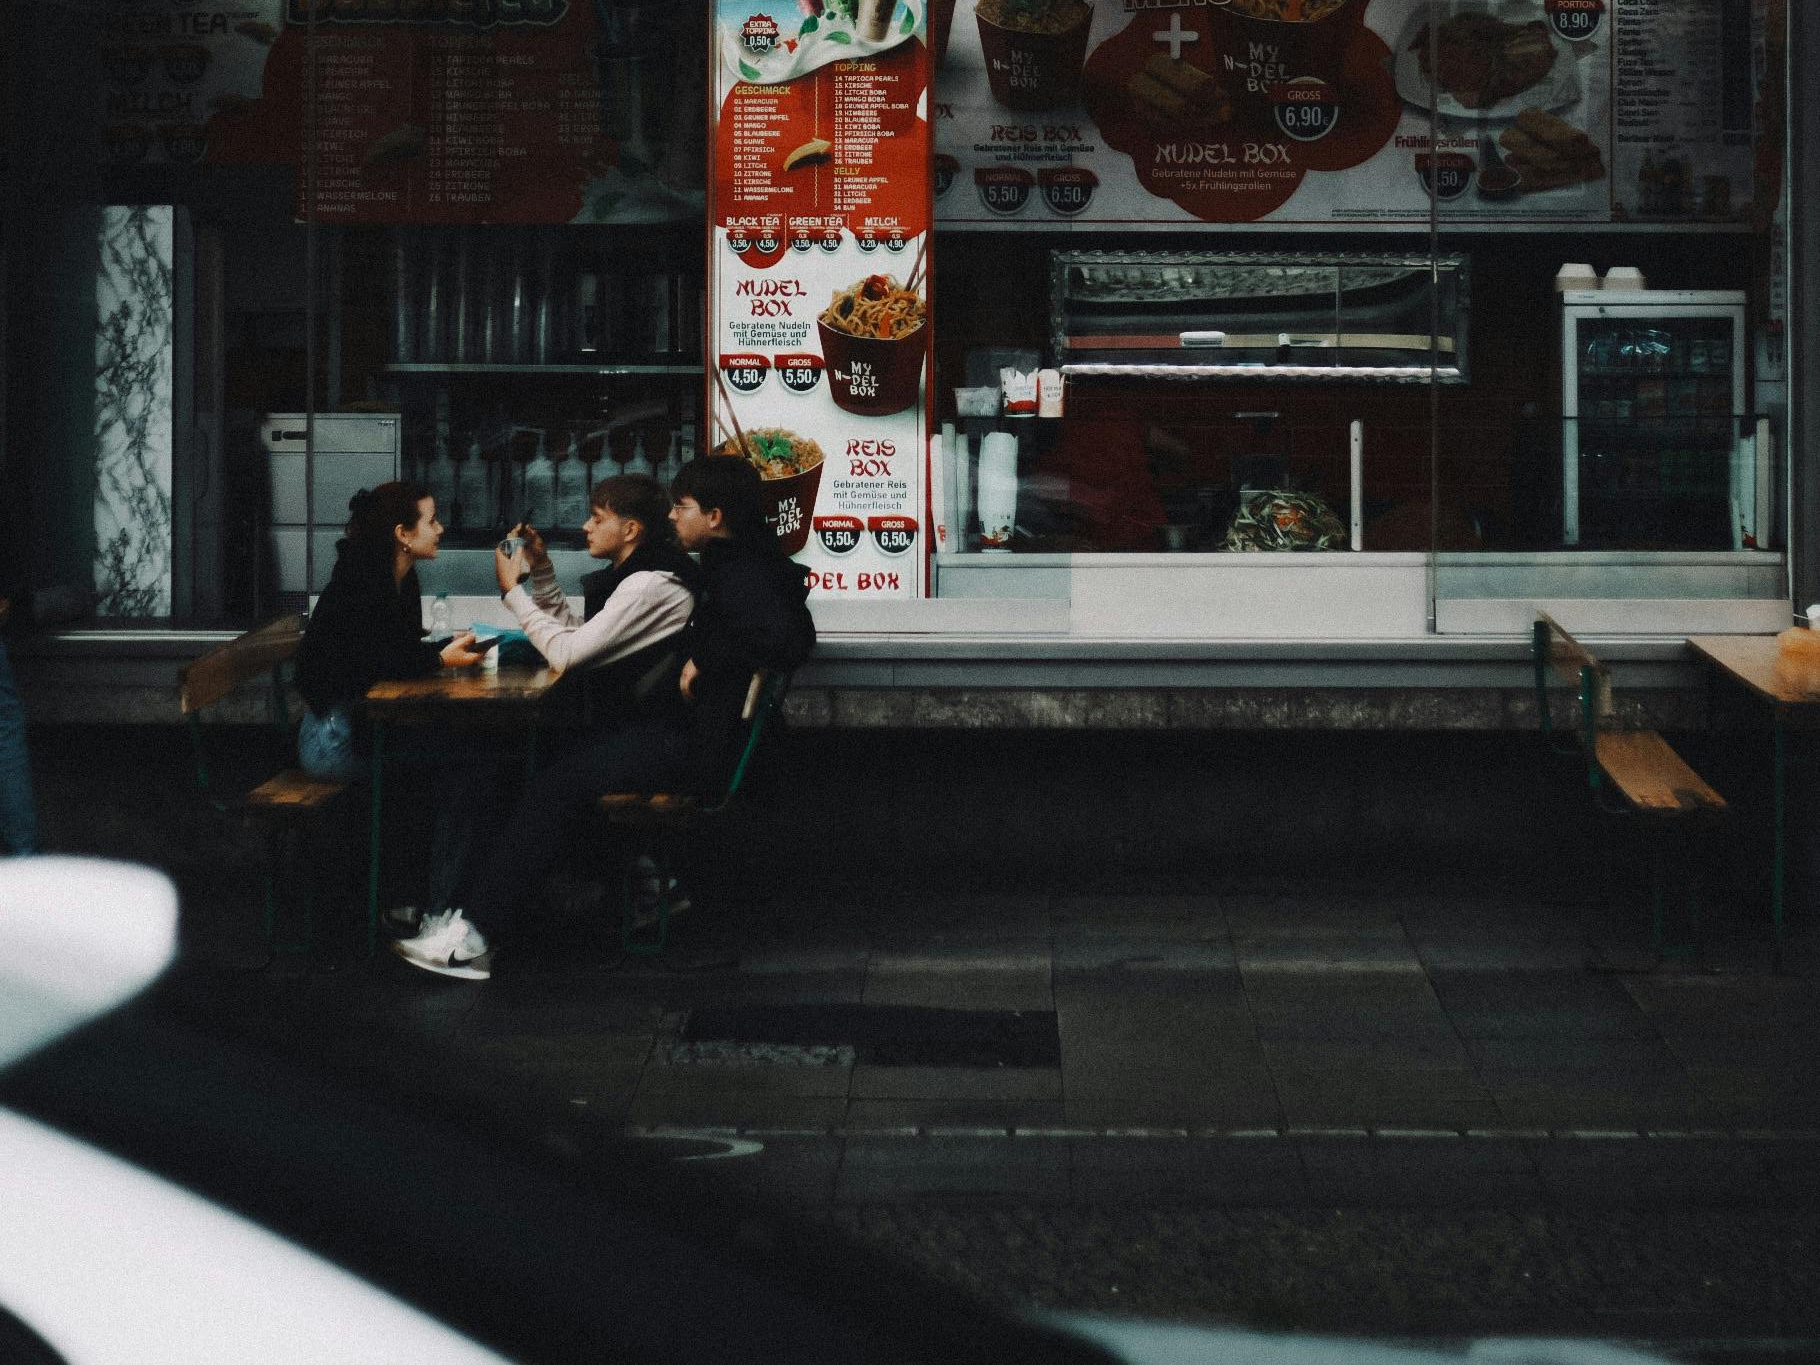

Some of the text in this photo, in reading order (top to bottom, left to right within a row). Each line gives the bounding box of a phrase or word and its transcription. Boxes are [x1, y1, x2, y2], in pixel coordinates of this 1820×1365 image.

[1558, 0, 1596, 8] PORTION
[749, 20, 772, 28] EXTRA
[745, 27, 777, 35] TOPPING
[1248, 41, 1278, 62] MY
[834, 63, 877, 72] TOPPING
[735, 86, 791, 95] GESCHMACK
[1287, 90, 1320, 100] GROSS
[990, 124, 1082, 142] REIS BOX
[1395, 136, 1479, 149] Frühlisrollen
[974, 144, 1020, 152] Gebratener
[1154, 143, 1292, 164] NUDEL BOX
[1152, 168, 1200, 178] Gebratene
[1204, 168, 1238, 178] Nudeln
[1240, 168, 1254, 178] mit
[1200, 180, 1272, 192] Frühlingsrollen
[726, 216, 780, 226] BLACK TEA
[789, 216, 842, 226] GREEN TEA
[865, 217, 898, 226] MILCH
[736, 279, 807, 296] NUDEL
[751, 299, 792, 316] BOX
[730, 322, 811, 330] Gebratene Nudeln
[734, 329, 807, 338] mit Gemüse und
[738, 338, 802, 346] Hühnerfleisch
[851, 360, 872, 375] MY
[732, 368, 764, 385] 4,50€
[786, 368, 818, 385] 5,50€
[850, 385, 876, 397] BOX
[846, 438, 896, 457] REIS
[850, 458, 892, 476] BOX
[833, 480, 907, 489] Gebratener Reis
[833, 490, 907, 499] mit Gemüse und
[778, 496, 797, 512] MY
[838, 501, 902, 510] Hühnerfleisch
[776, 520, 801, 536] BOX
[857, 572, 898, 590] BOX
